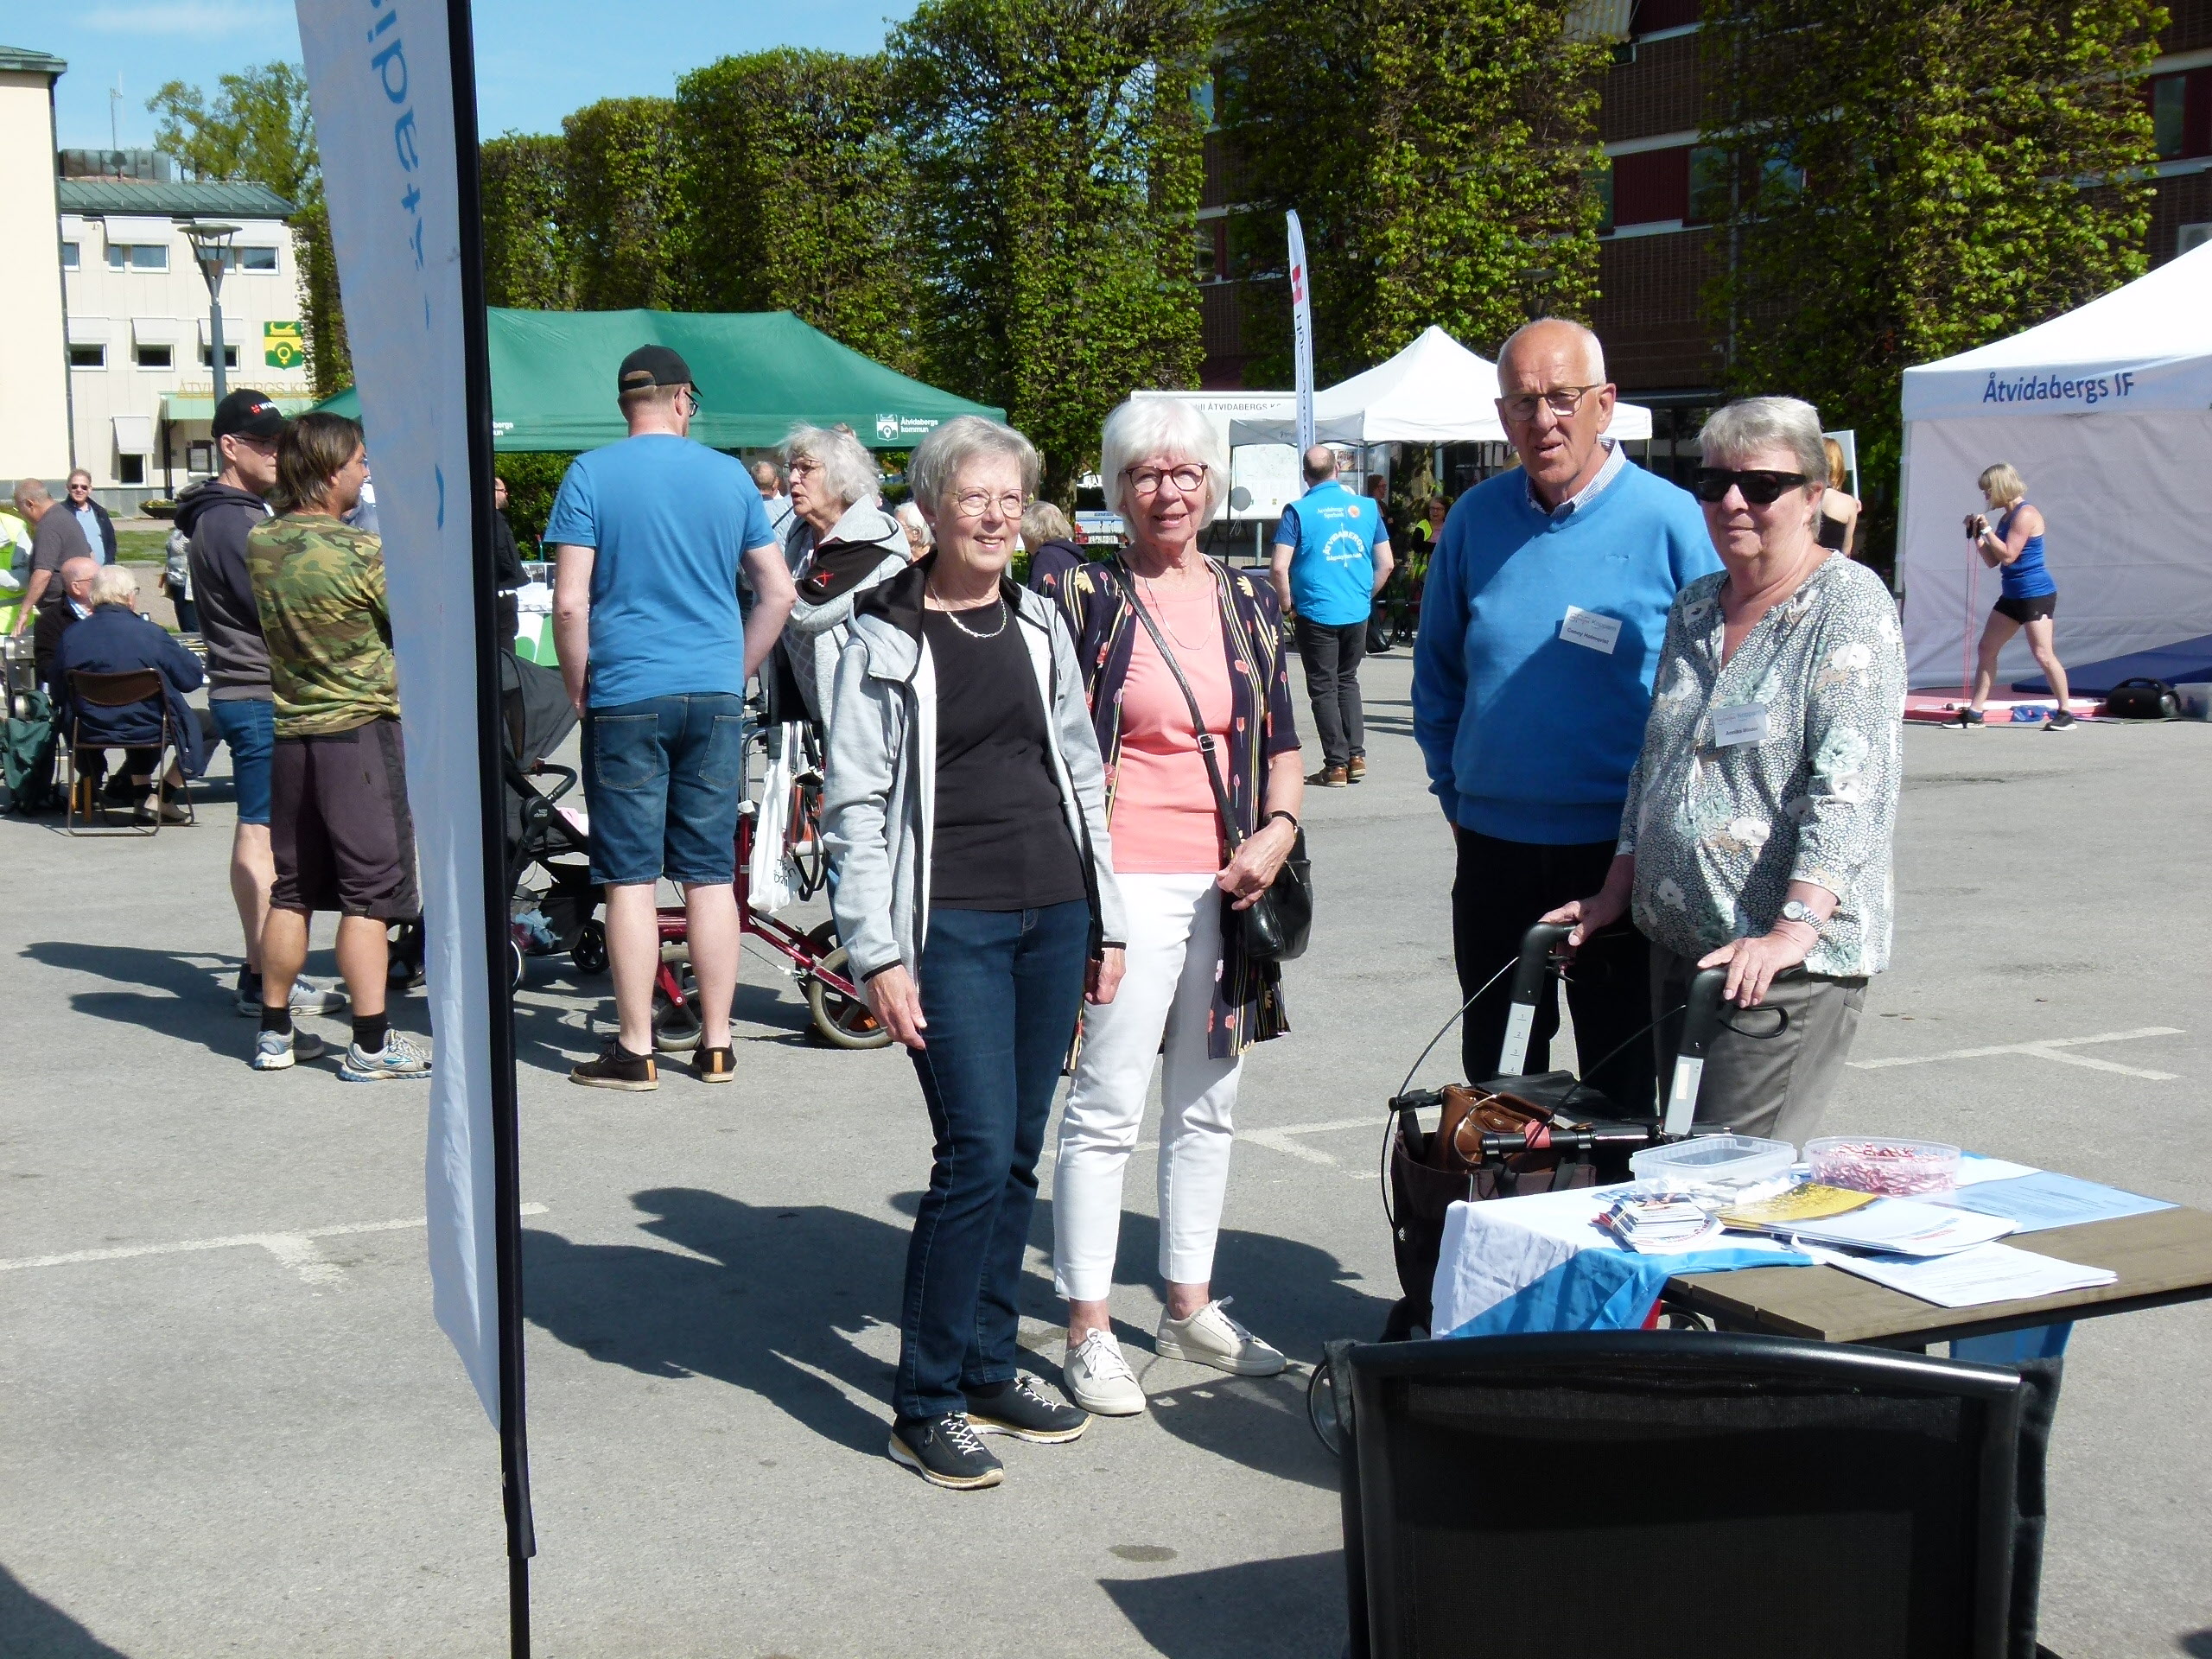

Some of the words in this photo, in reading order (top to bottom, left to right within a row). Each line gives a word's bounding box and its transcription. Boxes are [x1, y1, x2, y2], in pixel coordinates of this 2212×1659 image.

[1982, 372, 2109, 404] Åtvidabergs
[2114, 372, 2134, 396] IF
[1207, 402, 1268, 410] ÅTVIDABERGS
[900, 416, 938, 427] Åtvidabergs
[1567, 627, 1583, 637] Conny
